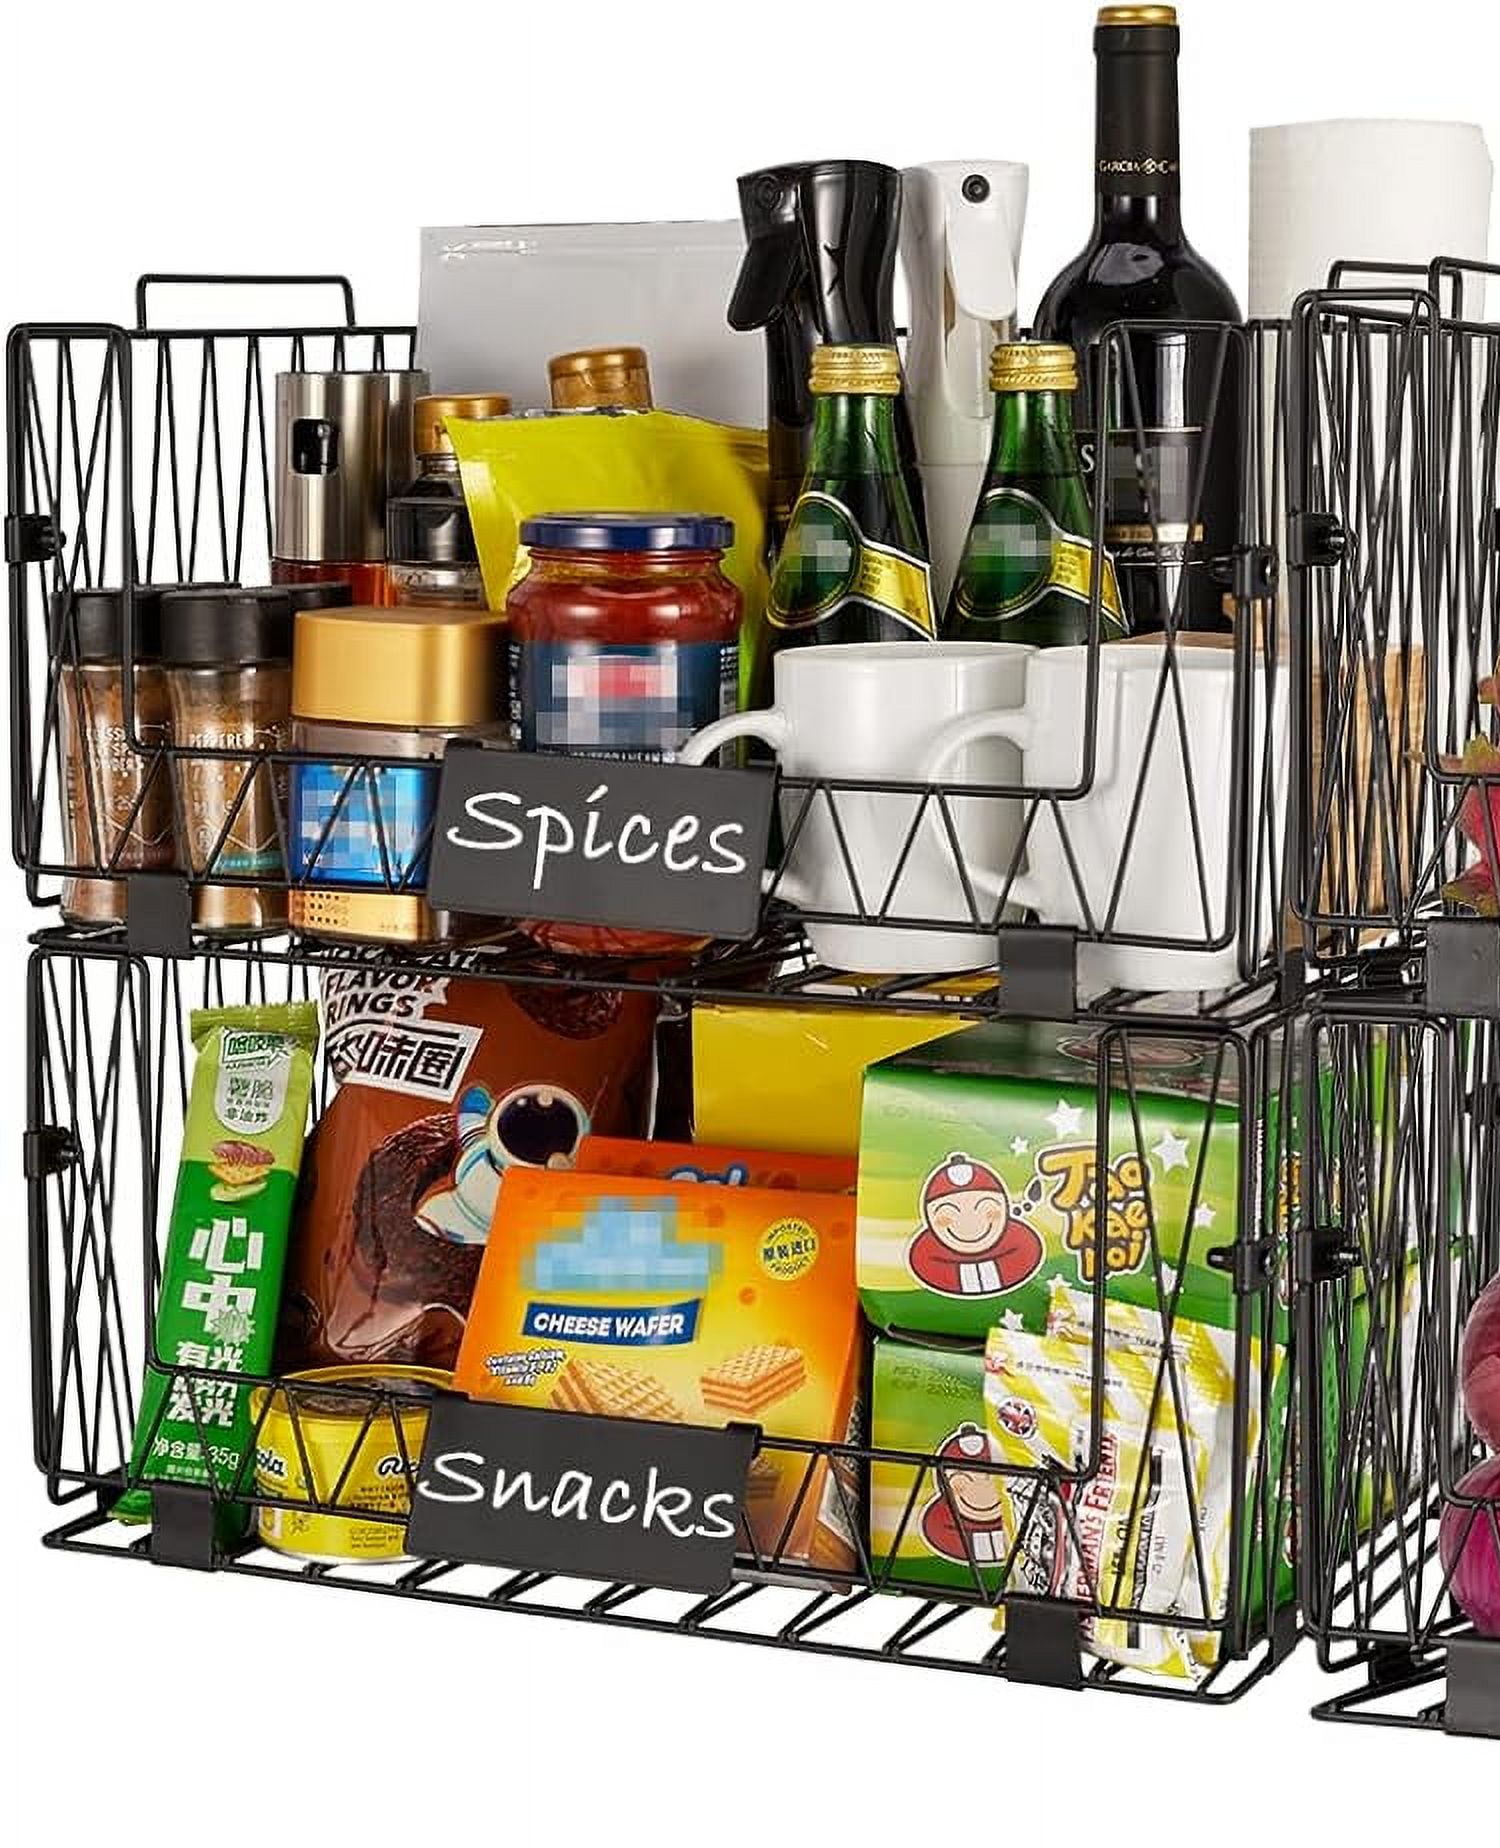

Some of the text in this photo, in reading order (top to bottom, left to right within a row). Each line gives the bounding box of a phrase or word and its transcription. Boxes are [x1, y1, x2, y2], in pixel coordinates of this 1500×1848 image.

[446, 784, 747, 890] Spices
[326, 991, 418, 1028] RINGS
[533, 1312, 685, 1338] CHEESE WAFER
[417, 1451, 736, 1538] Snacks
